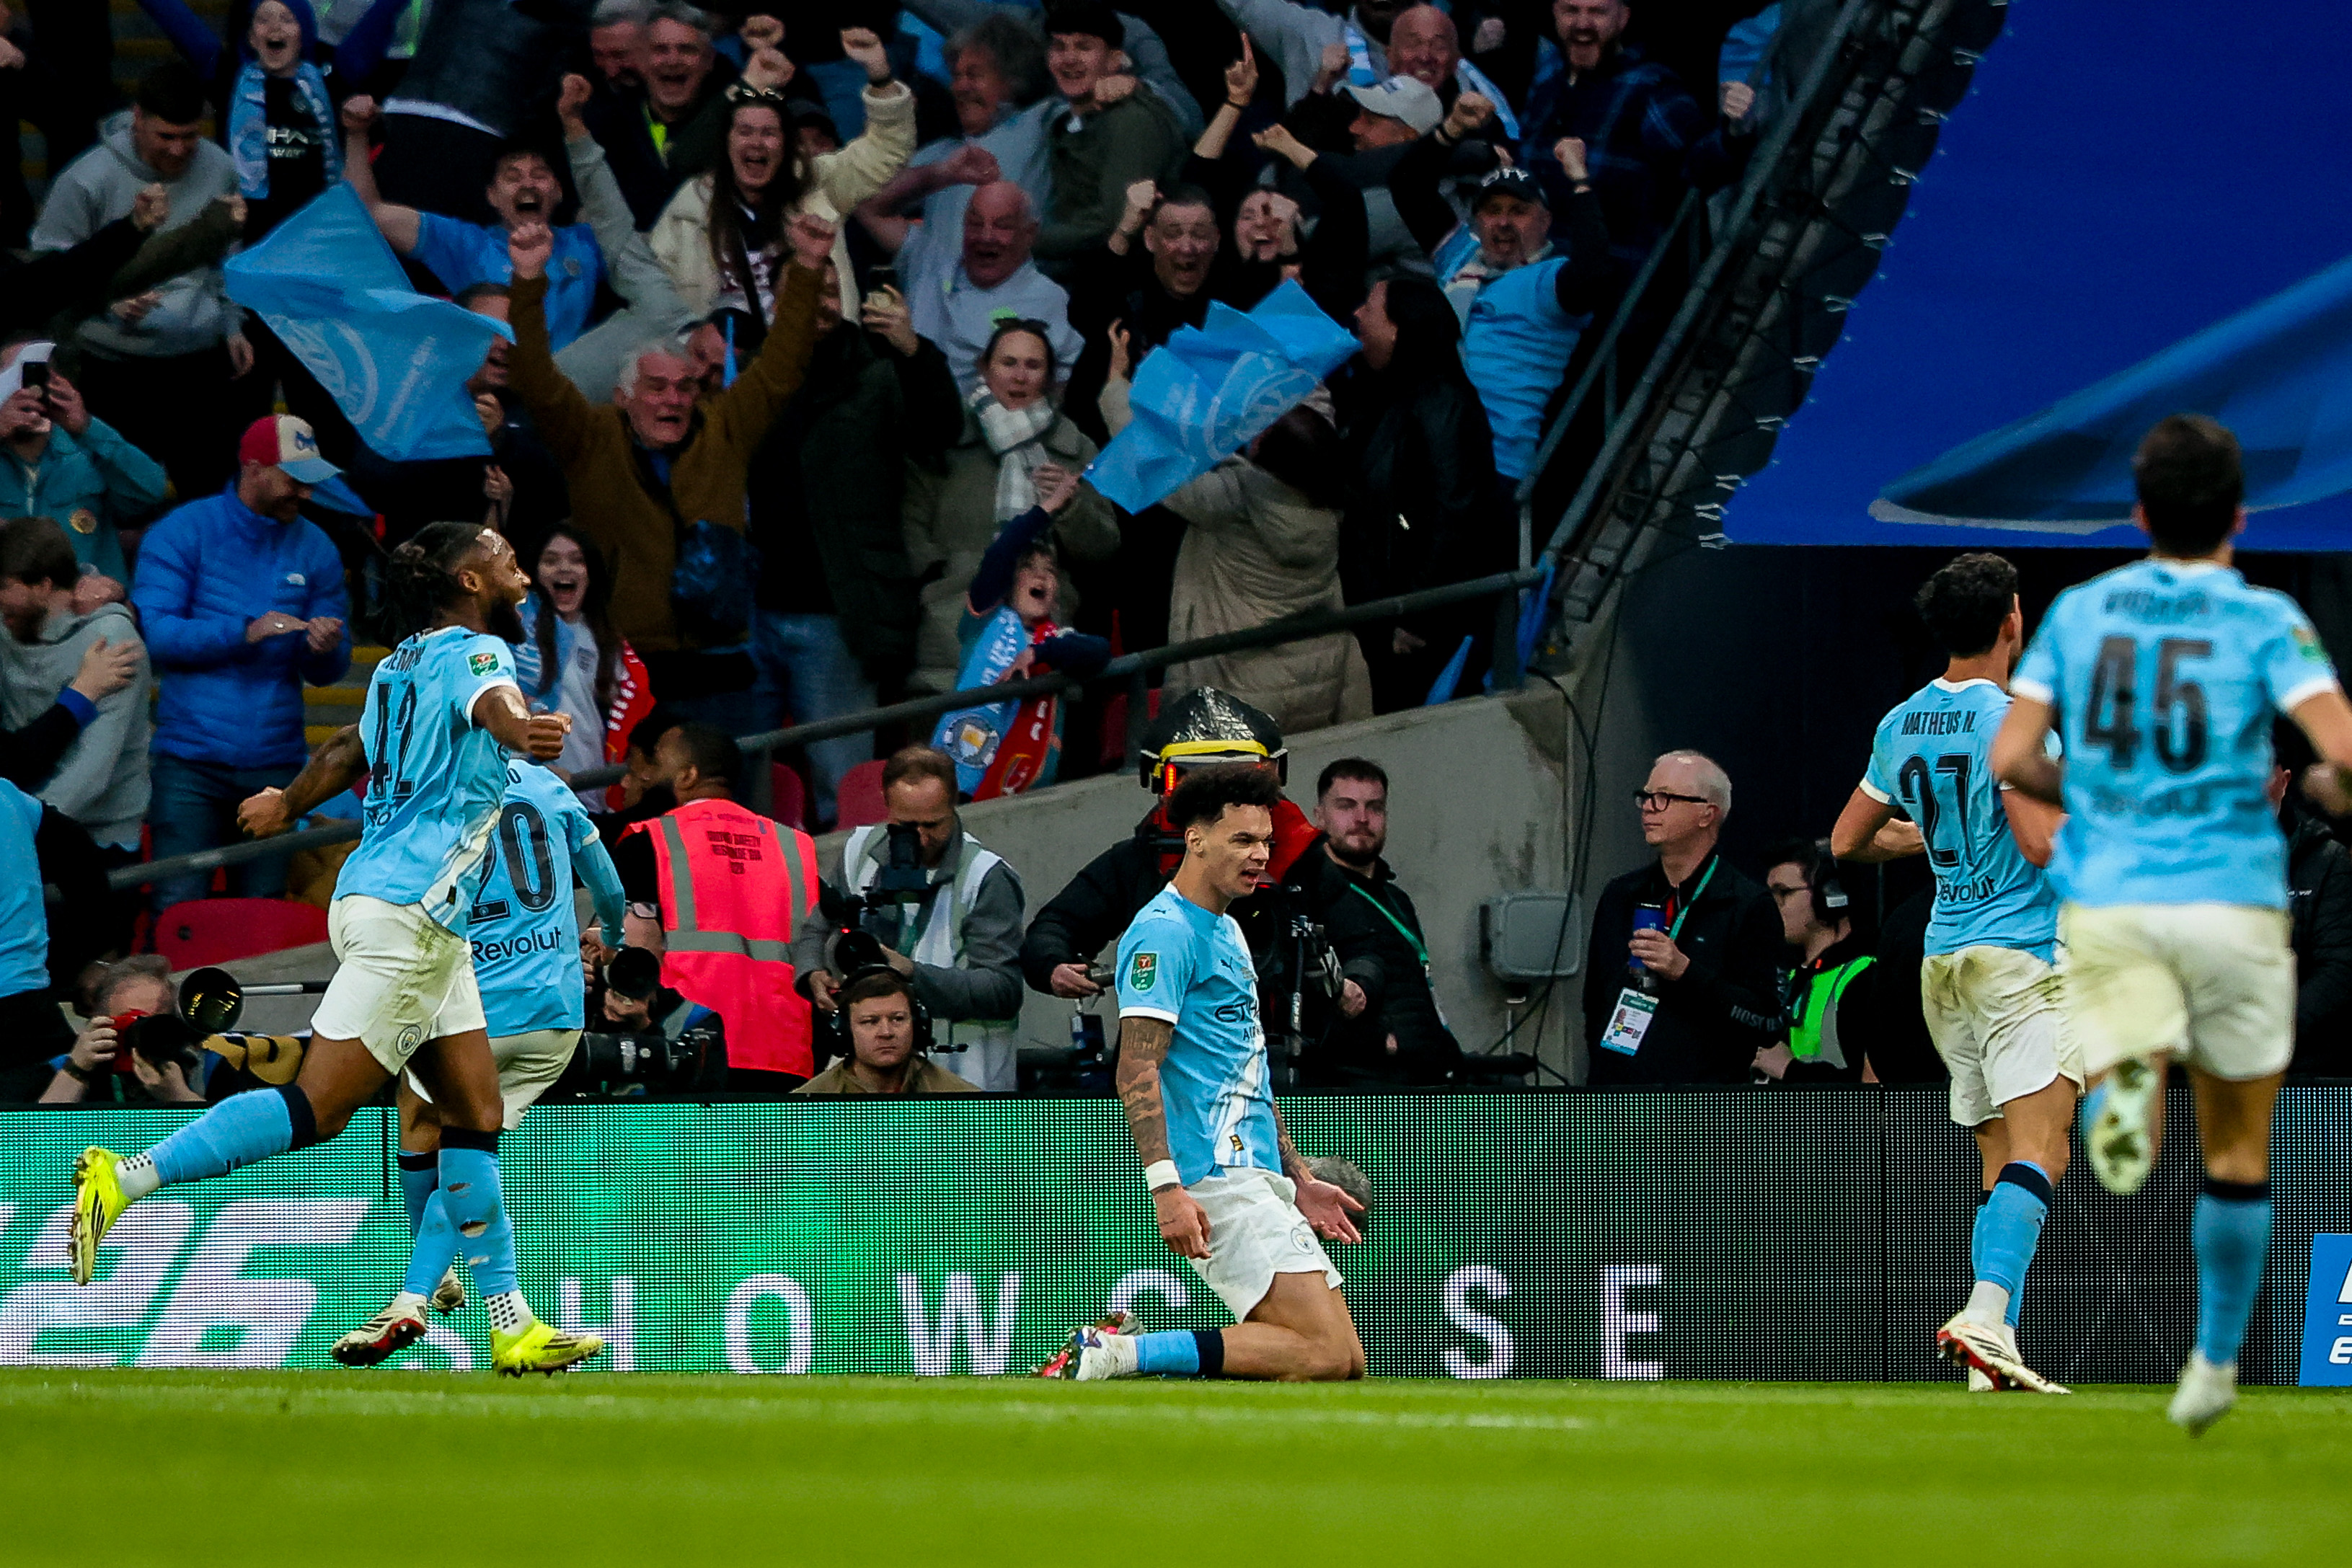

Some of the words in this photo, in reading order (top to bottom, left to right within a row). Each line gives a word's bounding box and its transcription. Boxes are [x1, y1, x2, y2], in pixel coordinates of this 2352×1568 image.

[371, 681, 417, 800] 42
[1901, 710, 1961, 735] MATHEUS
[1962, 710, 1977, 733] N.
[2084, 634, 2213, 774] 45
[468, 799, 556, 925] 20
[1898, 752, 1975, 867] 27
[470, 926, 561, 962] Revolut
